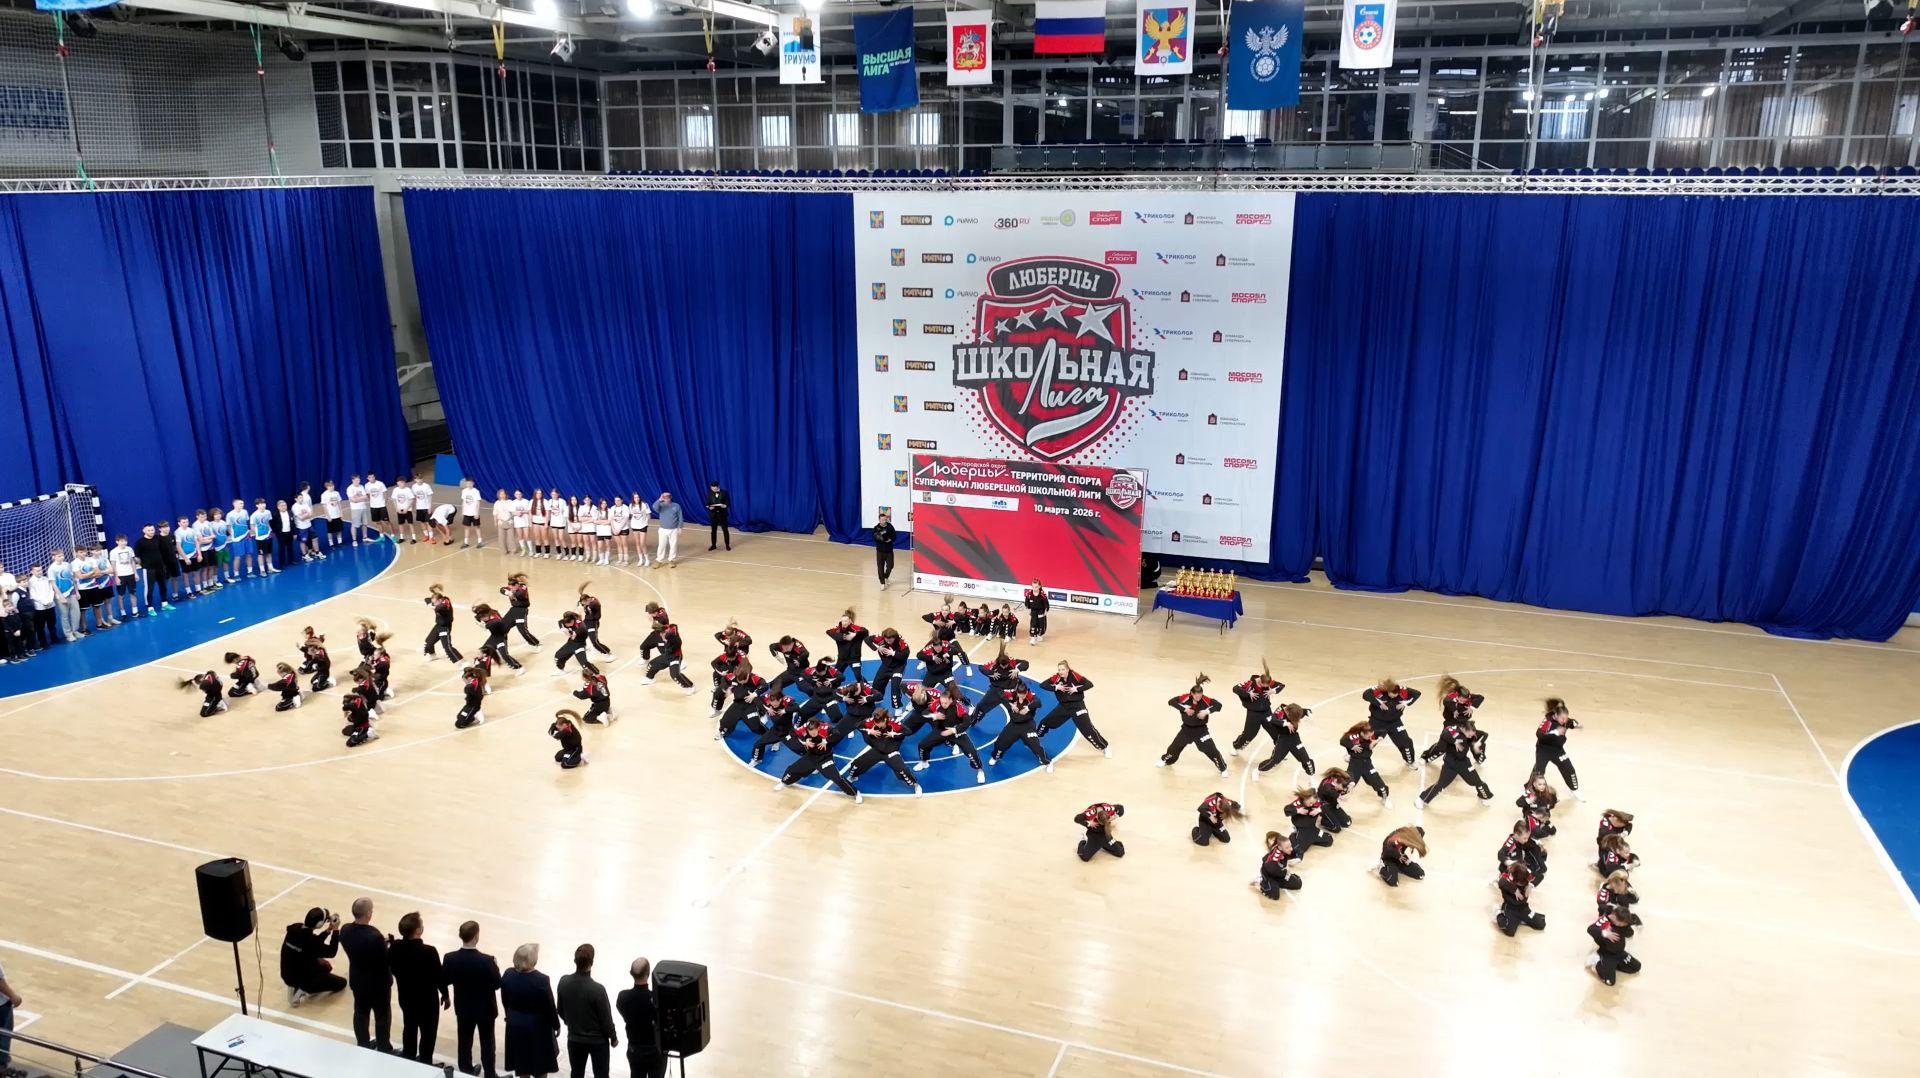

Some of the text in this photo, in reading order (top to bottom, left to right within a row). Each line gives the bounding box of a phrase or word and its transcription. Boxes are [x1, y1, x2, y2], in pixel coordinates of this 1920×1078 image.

[784, 54, 816, 65] ТРИУМФ
[863, 47, 912, 65] ВЫСШАЯ
[864, 63, 890, 76] ЛИГА
[997, 218, 1018, 228] 360
[1009, 267, 1100, 292] ЛЮБЕРЦЫ
[956, 343, 1150, 389] ШКОЛЬНАЯ
[915, 461, 1007, 481] Люберцы
[1010, 471, 1065, 484] ТЕРРИТОРИЯ
[1067, 475, 1102, 487] СПОРТА
[914, 477, 1102, 500] СУПЕРФИНАЛ ЛЮБЕРЕЦКОЙ ШКОЛЬНОЙ ЛИГИ
[1033, 504, 1042, 512] 10
[1044, 506, 1070, 515] марта
[1072, 508, 1094, 517] 2026
[1219, 535, 1251, 543] МОСОБЛ
[963, 582, 976, 590] 360
